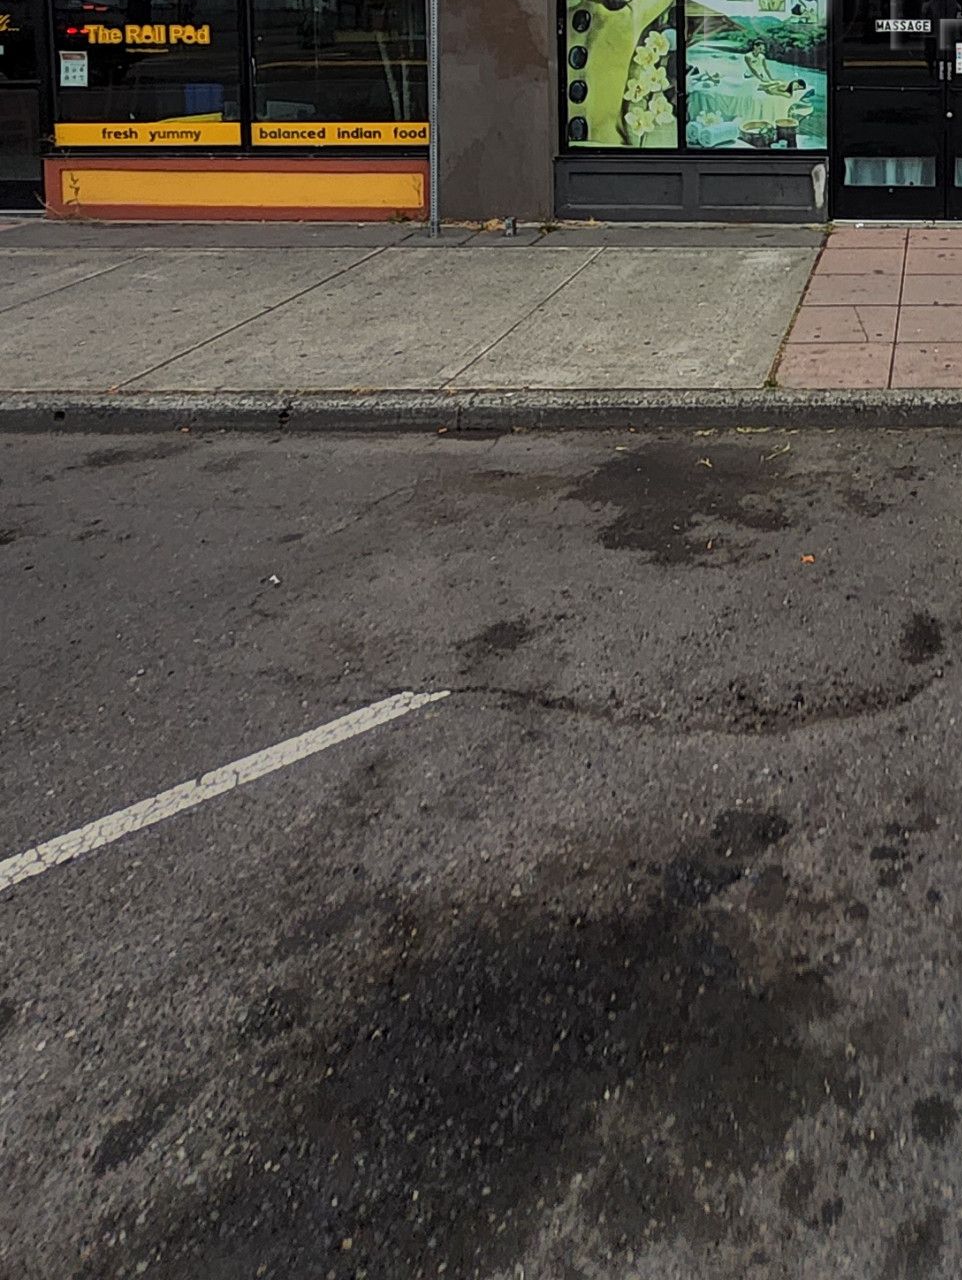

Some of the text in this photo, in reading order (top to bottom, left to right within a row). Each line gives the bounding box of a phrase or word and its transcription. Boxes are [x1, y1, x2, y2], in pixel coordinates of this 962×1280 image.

[876, 20, 930, 31] MASSAGE
[84, 24, 210, 44] The Roll Pod
[102, 128, 201, 142] fresh yummy
[259, 127, 427, 139] balanced indian food
